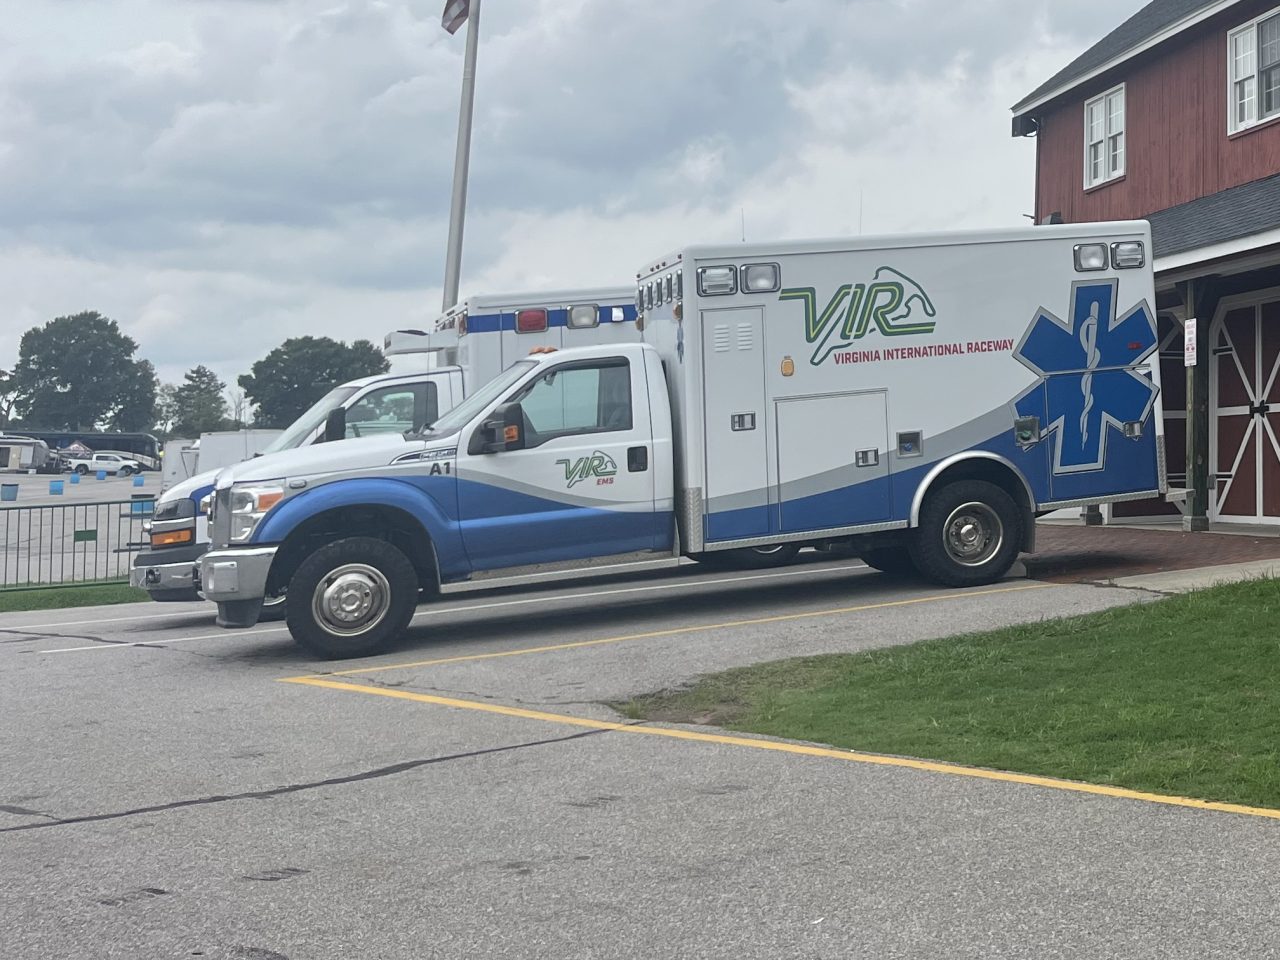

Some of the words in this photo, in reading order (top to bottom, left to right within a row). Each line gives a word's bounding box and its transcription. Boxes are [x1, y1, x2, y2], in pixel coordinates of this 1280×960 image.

[778, 281, 936, 344] VIR
[834, 349, 881, 365] VIRGINIA
[883, 342, 965, 361] INTERNATIONAL
[966, 339, 1015, 354] RACEWAY
[429, 461, 451, 476] A1
[555, 455, 618, 480] VIR
[596, 477, 615, 486] EMS
